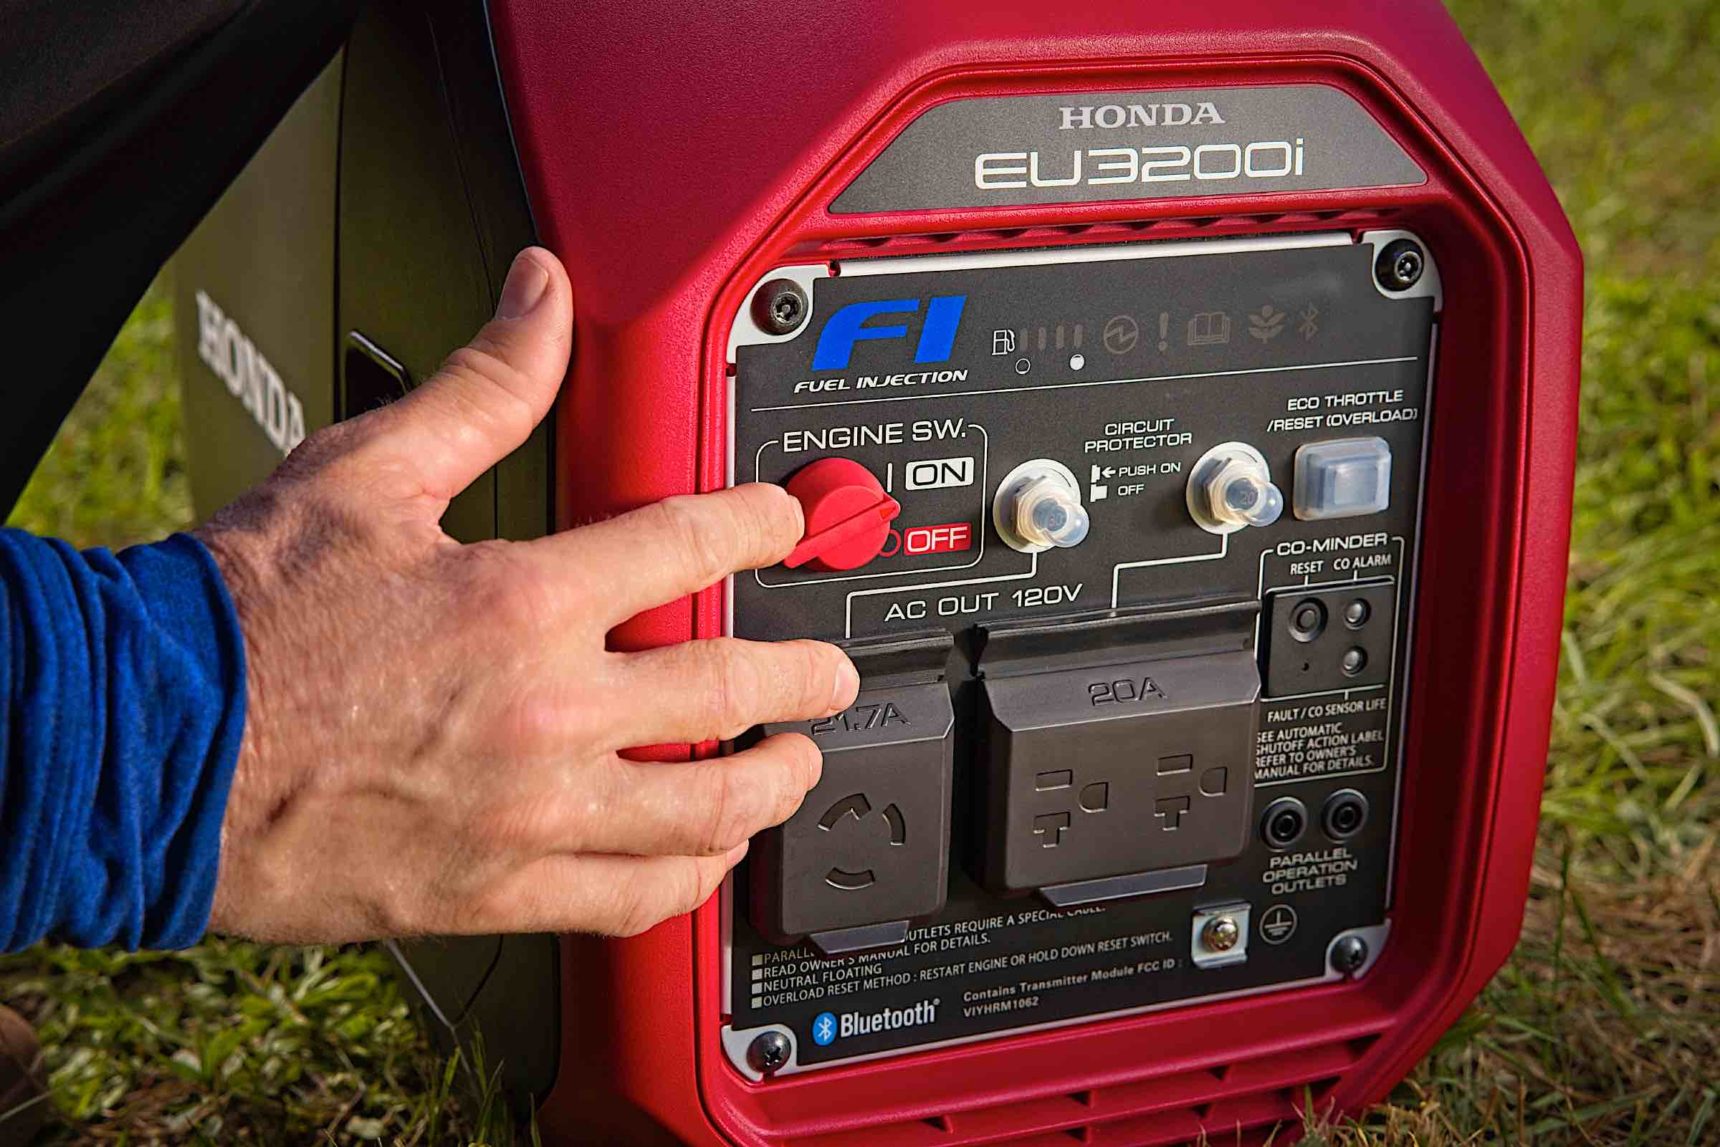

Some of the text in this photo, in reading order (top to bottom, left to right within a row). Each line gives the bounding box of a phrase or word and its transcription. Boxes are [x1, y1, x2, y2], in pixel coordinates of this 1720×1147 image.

[1059, 102, 1225, 130] HONDA
[975, 138, 1303, 189] EU3200i
[811, 295, 967, 371] FI
[196, 289, 305, 459] HONDA
[793, 369, 968, 394] FUEL INJECTION
[1288, 390, 1403, 411] ECO THROTTLE
[1266, 408, 1418, 432] /RESET (OVERLOAD)
[783, 418, 966, 452] ENGINE SW.
[1084, 418, 1192, 453] CIRCUIT PROTECTOR
[912, 461, 966, 486] ON
[1118, 461, 1181, 477] PUSH ON
[1118, 483, 1145, 496] OFF
[907, 525, 967, 552] OFF
[1277, 533, 1387, 556] CO-MINDER
[1290, 554, 1391, 575] RESET CO ALARM
[884, 583, 1083, 621] AC OUT 120V
[1087, 676, 1167, 707] 20A
[1267, 707, 1299, 722] FAULT
[1308, 705, 1322, 718] CO
[1325, 700, 1364, 716] SENSOR
[1366, 698, 1386, 711] LIFE
[1276, 722, 1343, 740] AUTOMATIC
[1306, 734, 1349, 749] ACTION
[1351, 730, 1384, 744] LABEL
[1288, 751, 1304, 763] TO
[1306, 745, 1357, 761] OWNER'S
[1254, 765, 1300, 779] MANUAL
[1303, 761, 1325, 773] FOR
[1269, 847, 1352, 868] PARALLEL
[1262, 859, 1358, 883] OPERATION
[1271, 874, 1347, 895] OUTLETS
[906, 924, 951, 941] UTLETS
[954, 915, 1003, 934] REQUIRE
[1006, 914, 1016, 926] A
[764, 963, 797, 978] READ
[914, 940, 937, 954] FOR
[941, 932, 991, 950] DETAILS.
[763, 987, 825, 1007] OVERLOAD
[827, 981, 860, 996] RESET
[863, 973, 911, 991] METHOD
[920, 963, 966, 981] RESTART
[968, 956, 1008, 973] ENGINE
[1010, 953, 1026, 966] OR
[1028, 948, 1059, 963] HOLD
[1061, 942, 1095, 958] DOWN
[1098, 937, 1127, 952] RESET
[763, 963, 882, 993] NEUTRAL FLOATING
[963, 985, 1016, 1002] Contains
[1019, 974, 1088, 992] Transmitter
[1091, 963, 1134, 981] Module
[1137, 960, 1160, 973] FCC
[1163, 958, 1175, 970] ID
